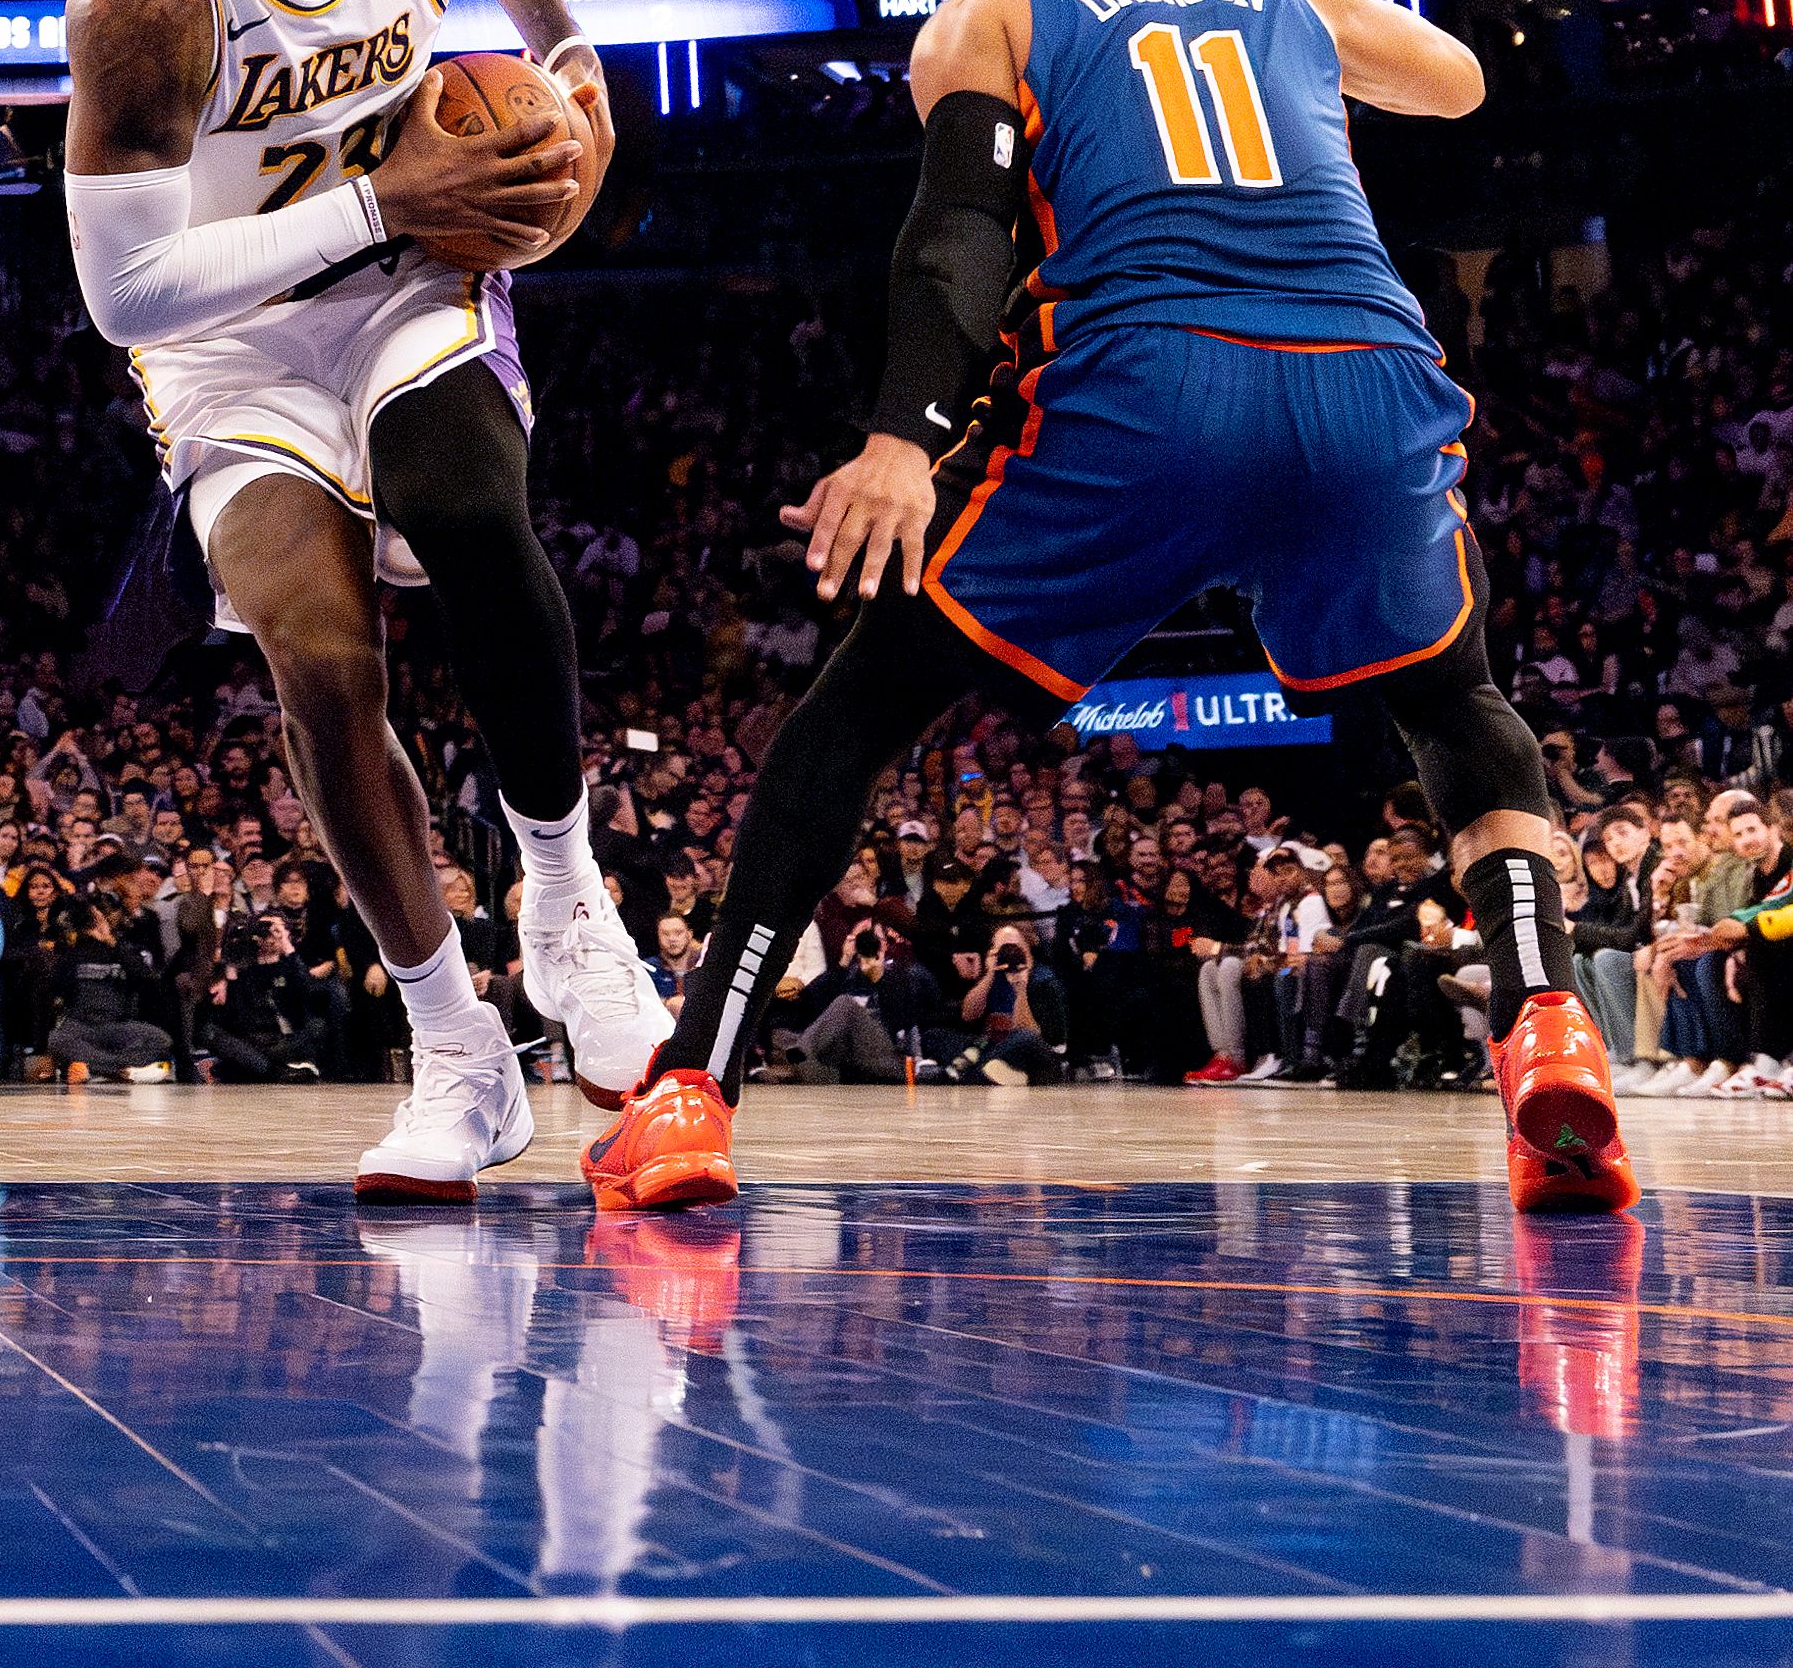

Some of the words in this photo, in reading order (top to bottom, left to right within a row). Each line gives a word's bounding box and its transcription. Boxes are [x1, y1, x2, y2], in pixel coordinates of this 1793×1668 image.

[209, 12, 415, 135] LAKERS
[1127, 21, 1285, 189] 11
[364, 189, 383, 234] PROMISE
[1072, 696, 1169, 733] Michelob
[1195, 691, 1298, 727] ULTR
